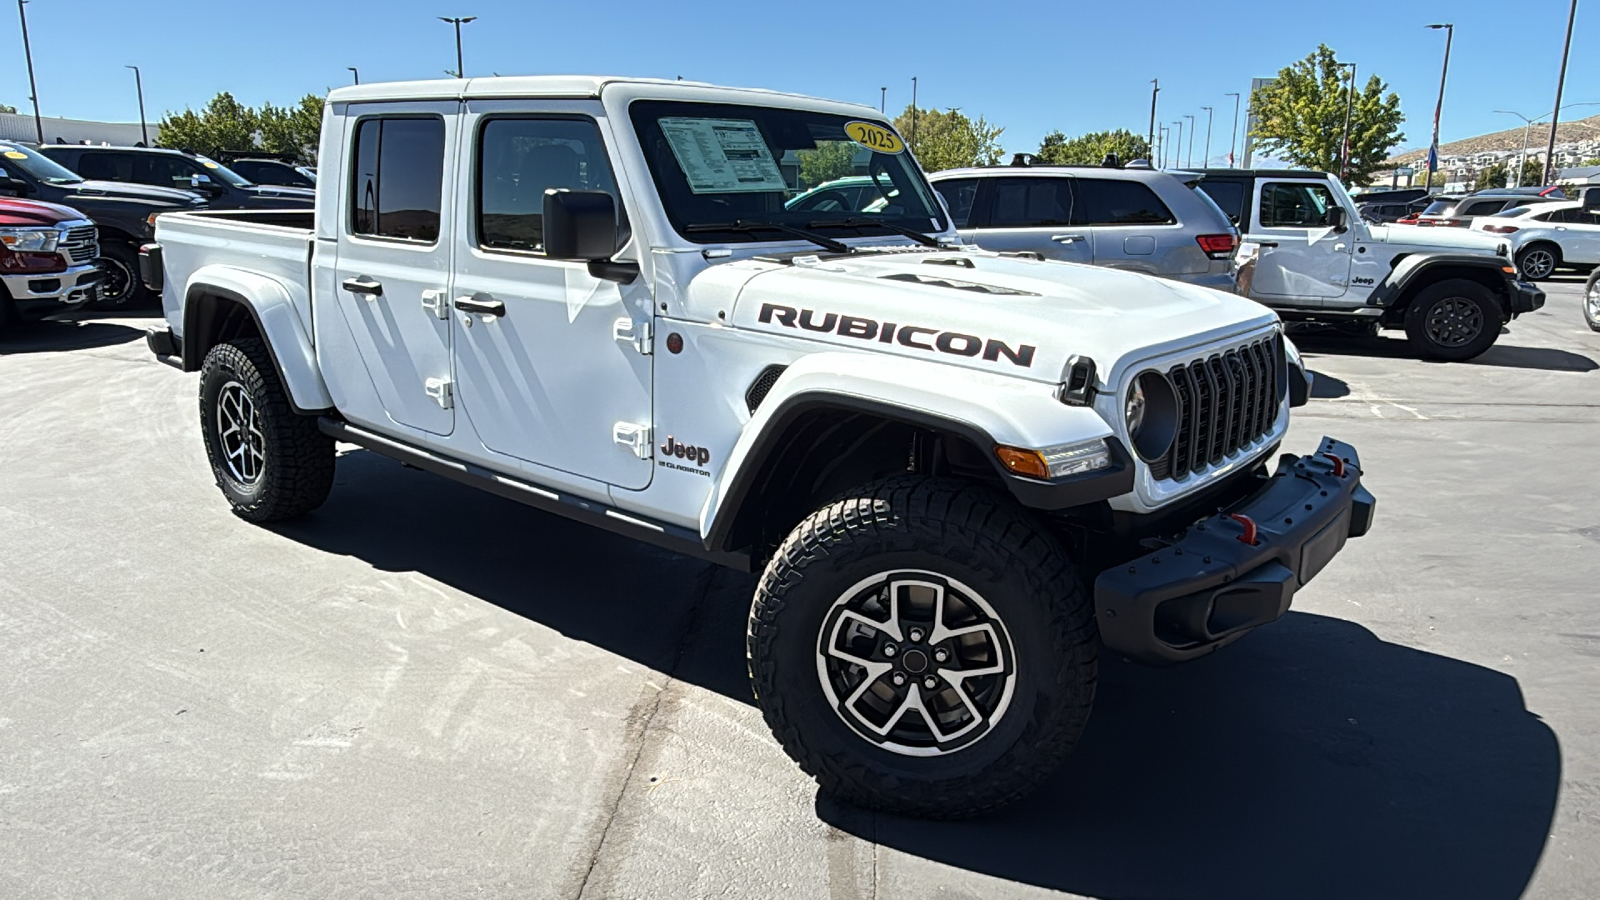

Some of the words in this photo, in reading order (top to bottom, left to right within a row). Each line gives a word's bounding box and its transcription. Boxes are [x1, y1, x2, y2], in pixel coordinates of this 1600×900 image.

[857, 126, 895, 149] 2025
[1351, 276, 1374, 286] Jeep
[758, 302, 1036, 368] RUBICON
[660, 434, 710, 467] Jeep
[666, 461, 711, 477] GLADIATOR
